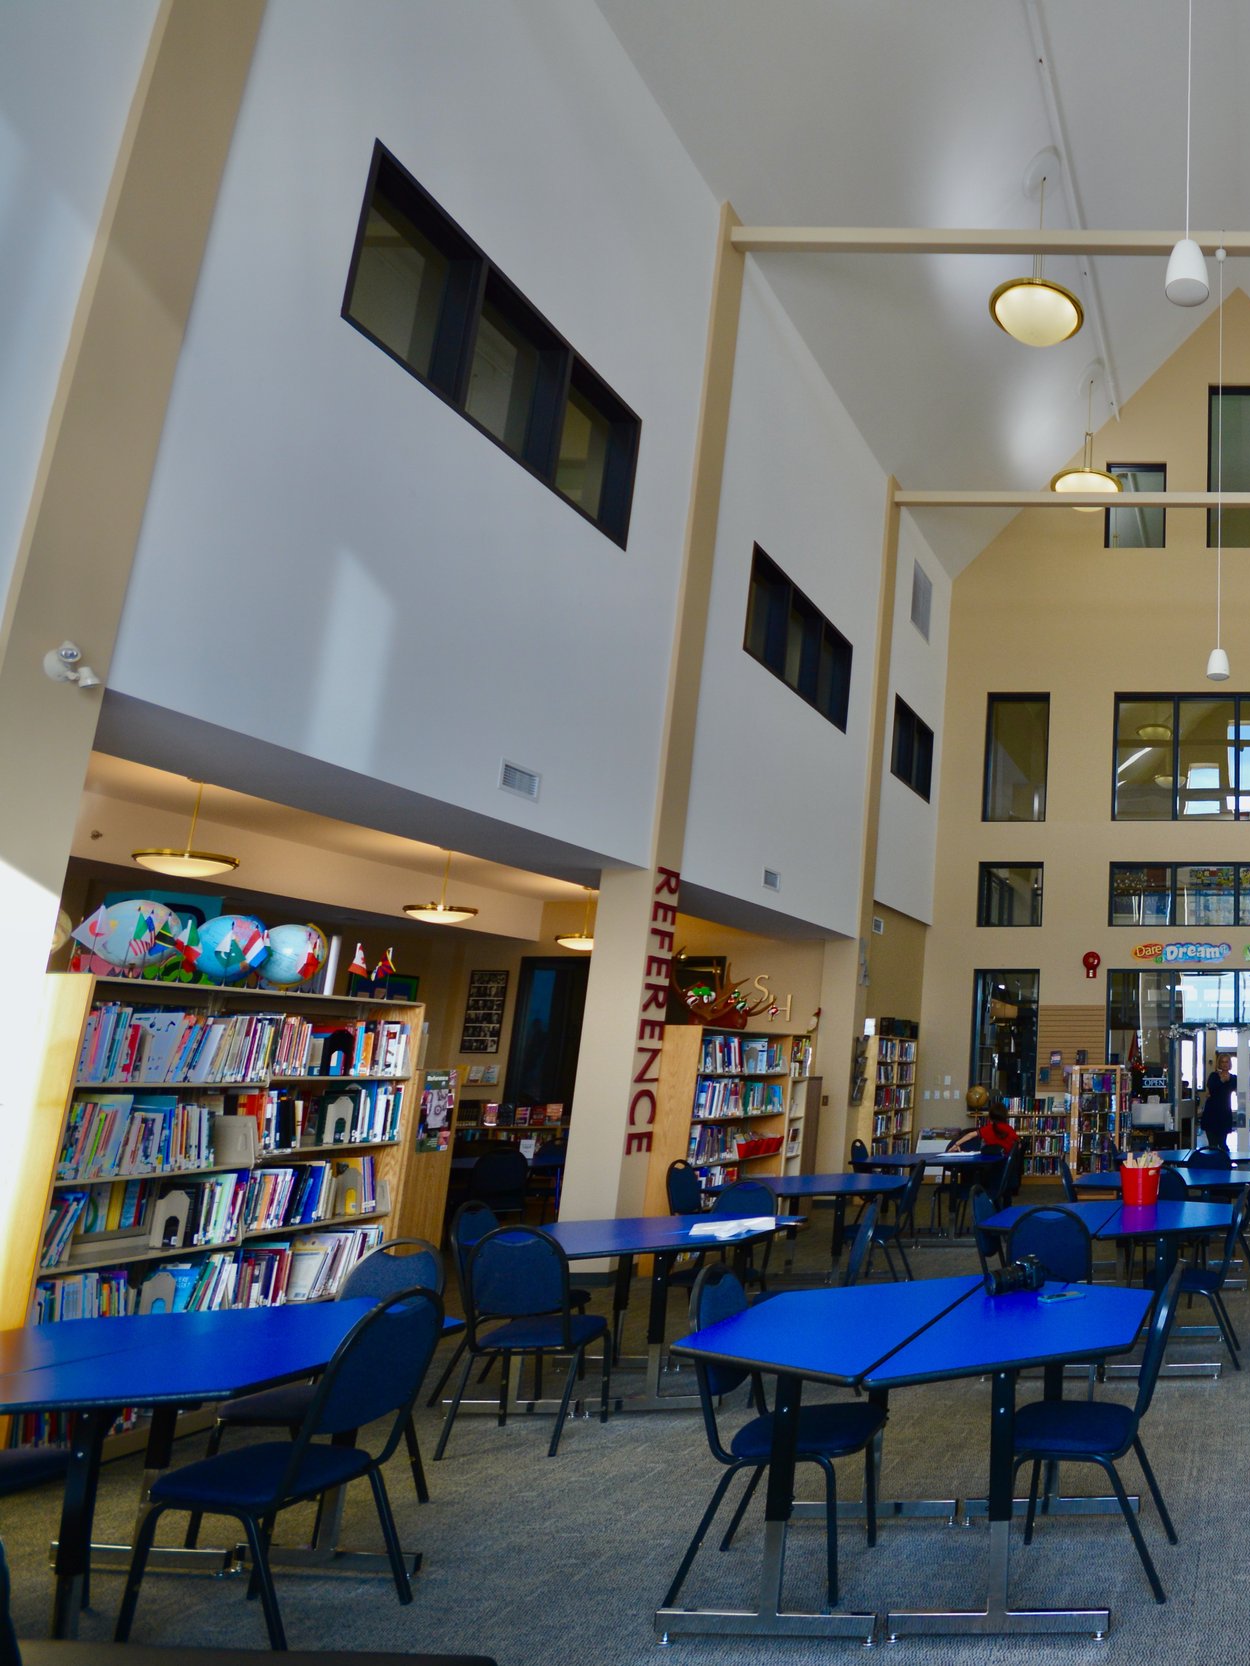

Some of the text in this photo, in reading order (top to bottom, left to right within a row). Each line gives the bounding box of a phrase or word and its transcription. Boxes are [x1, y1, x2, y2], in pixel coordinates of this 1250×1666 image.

[1136, 945, 1162, 957] Dare
[1166, 945, 1220, 961] Dream
[625, 866, 681, 1156] REFERENCE
[1143, 1079, 1165, 1087] OPEN
